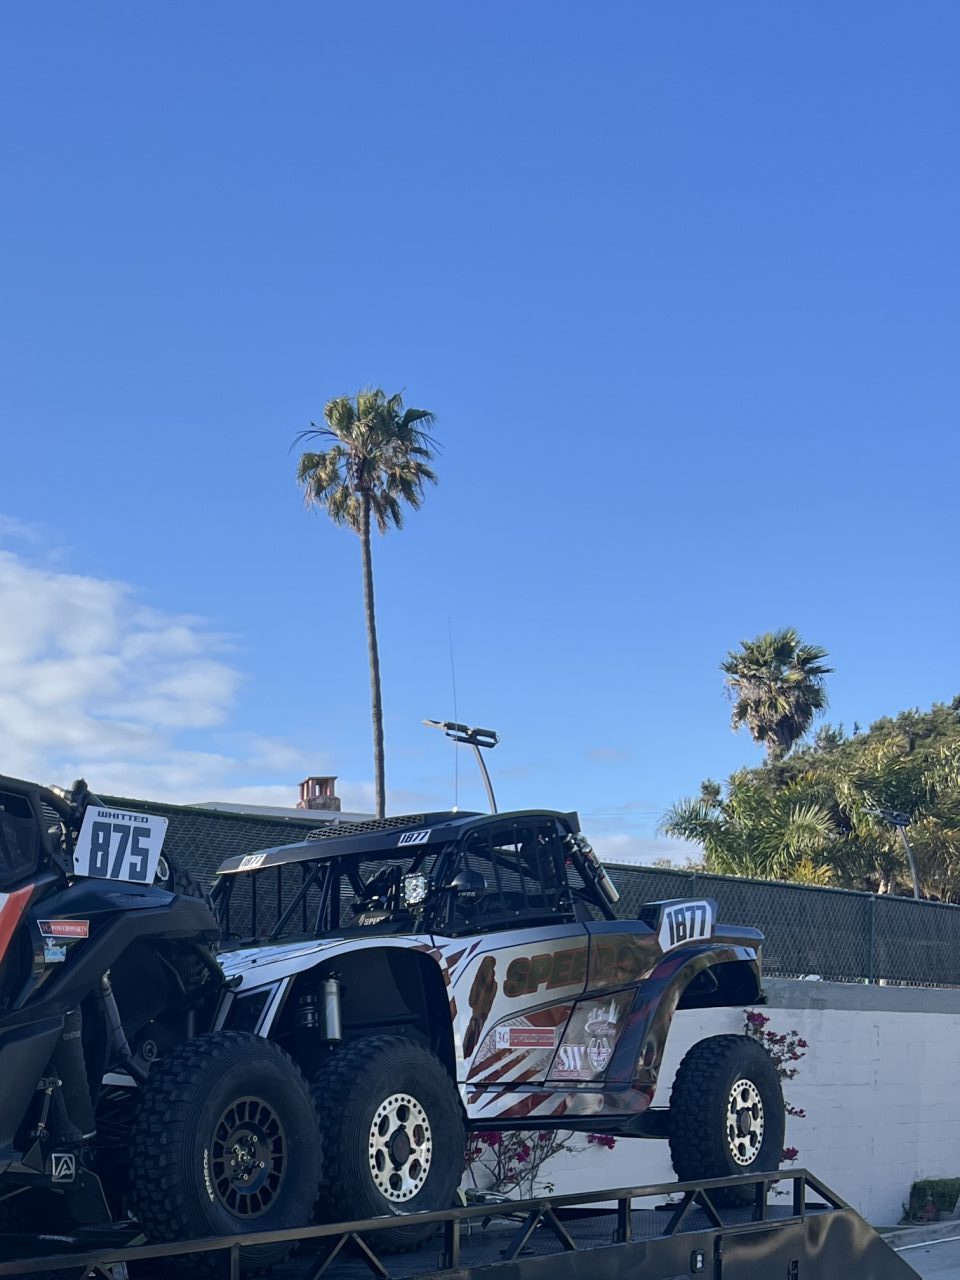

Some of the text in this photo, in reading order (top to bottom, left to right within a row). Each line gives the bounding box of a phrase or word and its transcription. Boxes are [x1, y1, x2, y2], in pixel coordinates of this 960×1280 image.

[97, 810, 149, 824] WHITTED
[401, 831, 428, 844] 1877
[89, 821, 151, 881] 875
[242, 854, 264, 867] 1877
[666, 905, 707, 946] 1877
